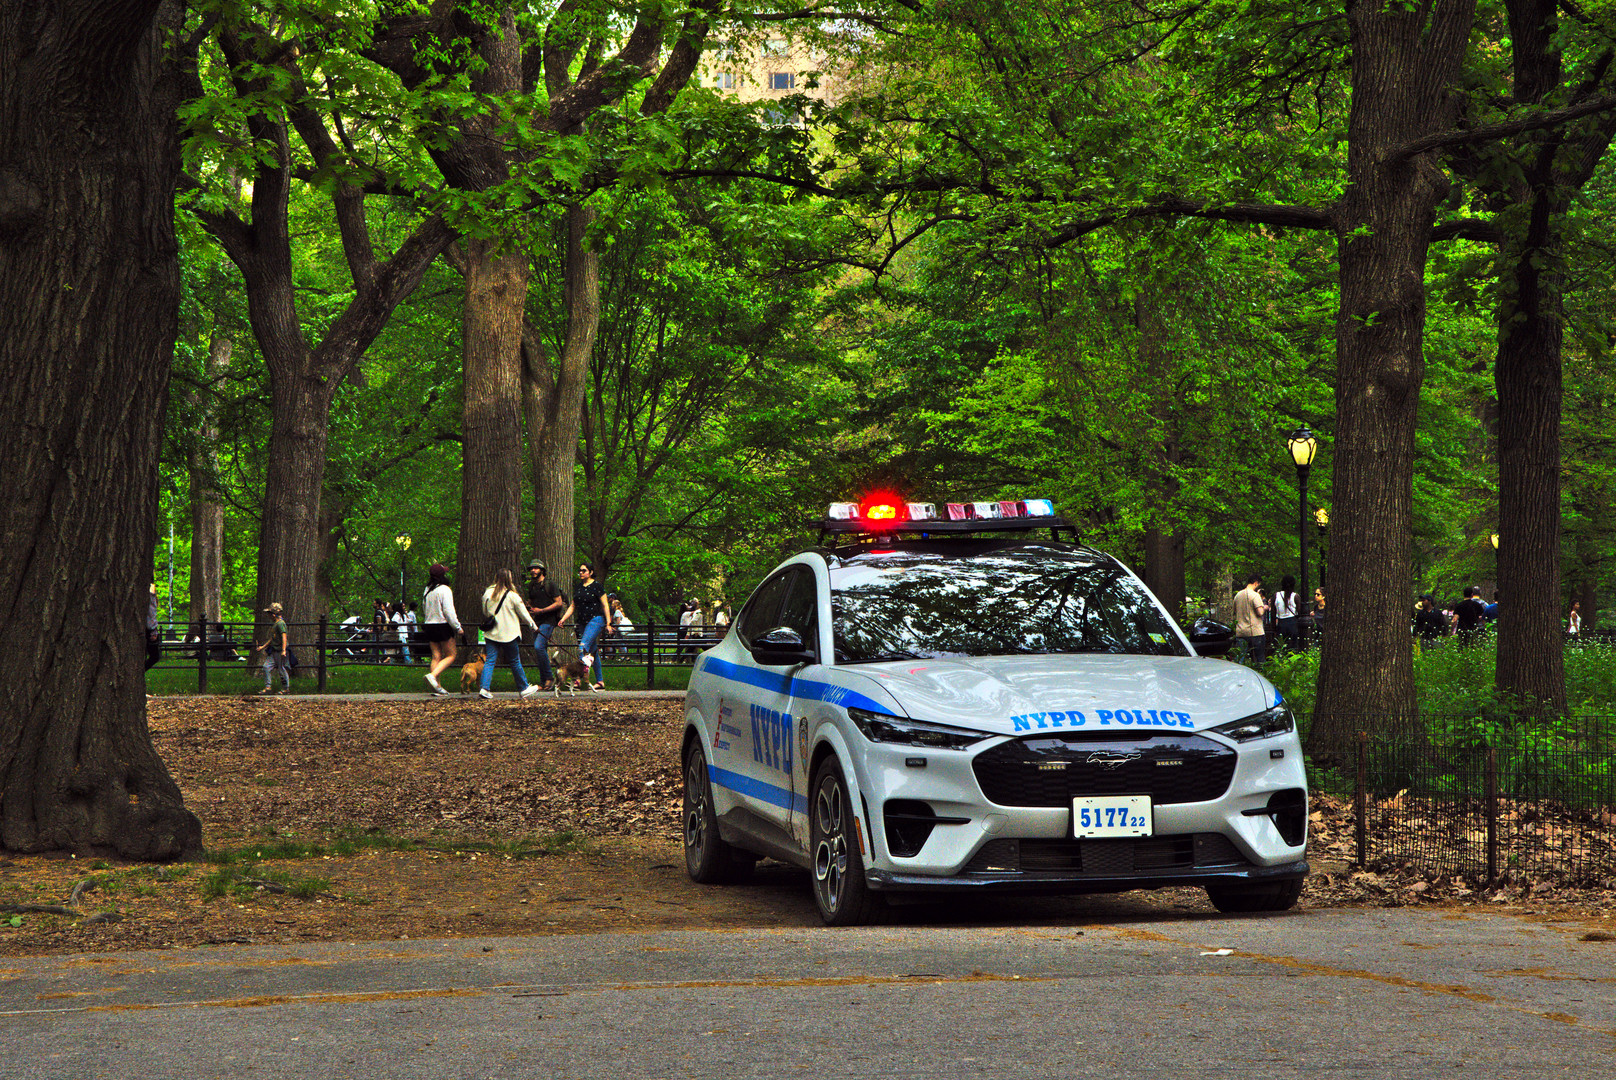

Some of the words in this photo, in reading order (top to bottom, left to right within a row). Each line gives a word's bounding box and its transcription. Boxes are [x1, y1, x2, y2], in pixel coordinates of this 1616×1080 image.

[1010, 710, 1086, 732] NYPD
[1095, 709, 1195, 729] POLICE
[750, 703, 793, 774] NYPD
[1080, 807, 1129, 828] 5177
[1130, 816, 1146, 827] 22
